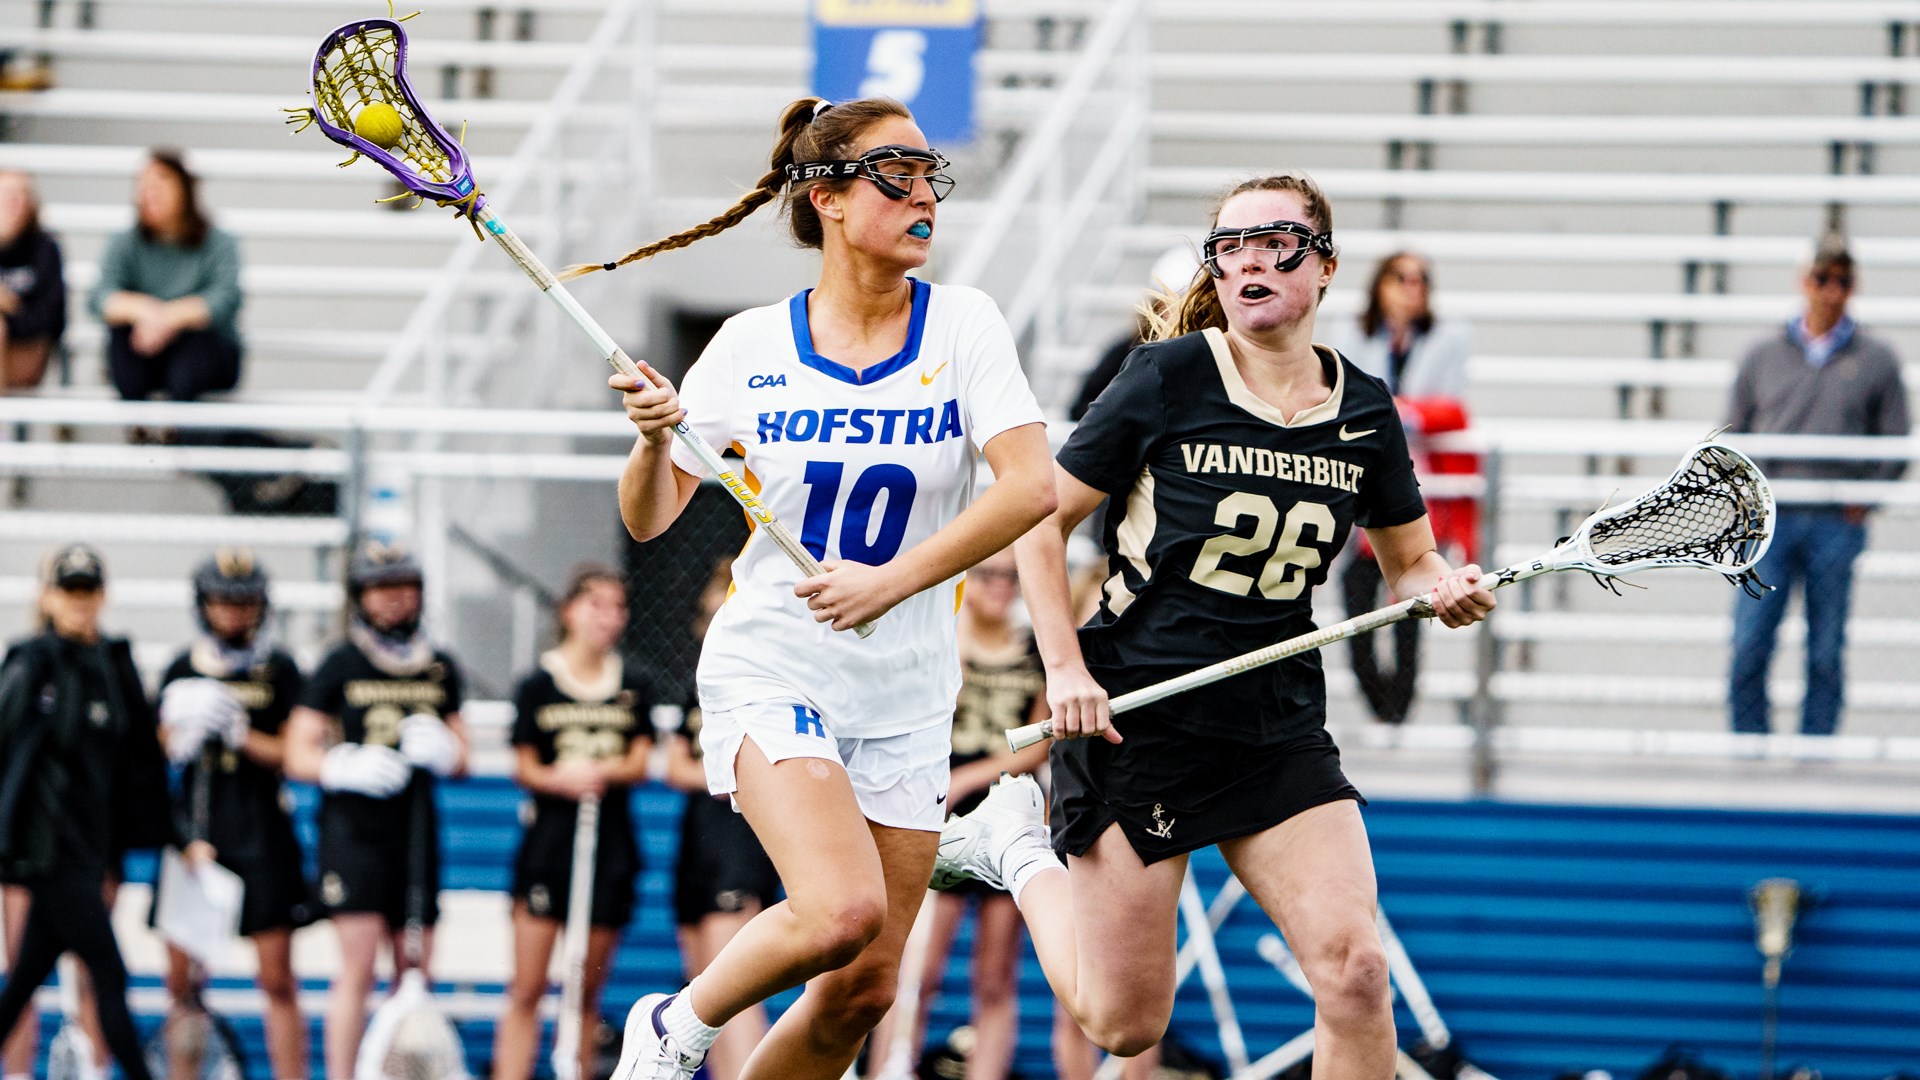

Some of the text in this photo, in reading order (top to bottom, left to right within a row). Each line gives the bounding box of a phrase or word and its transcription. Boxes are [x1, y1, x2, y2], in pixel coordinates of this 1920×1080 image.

[805, 165, 834, 179] STX
[747, 374, 787, 389] CAA
[756, 398, 964, 445] HOFSTRA
[1180, 443, 1365, 494] VANDERBILT
[800, 460, 918, 567] 10
[1188, 490, 1337, 600] 26
[791, 704, 826, 739] H
